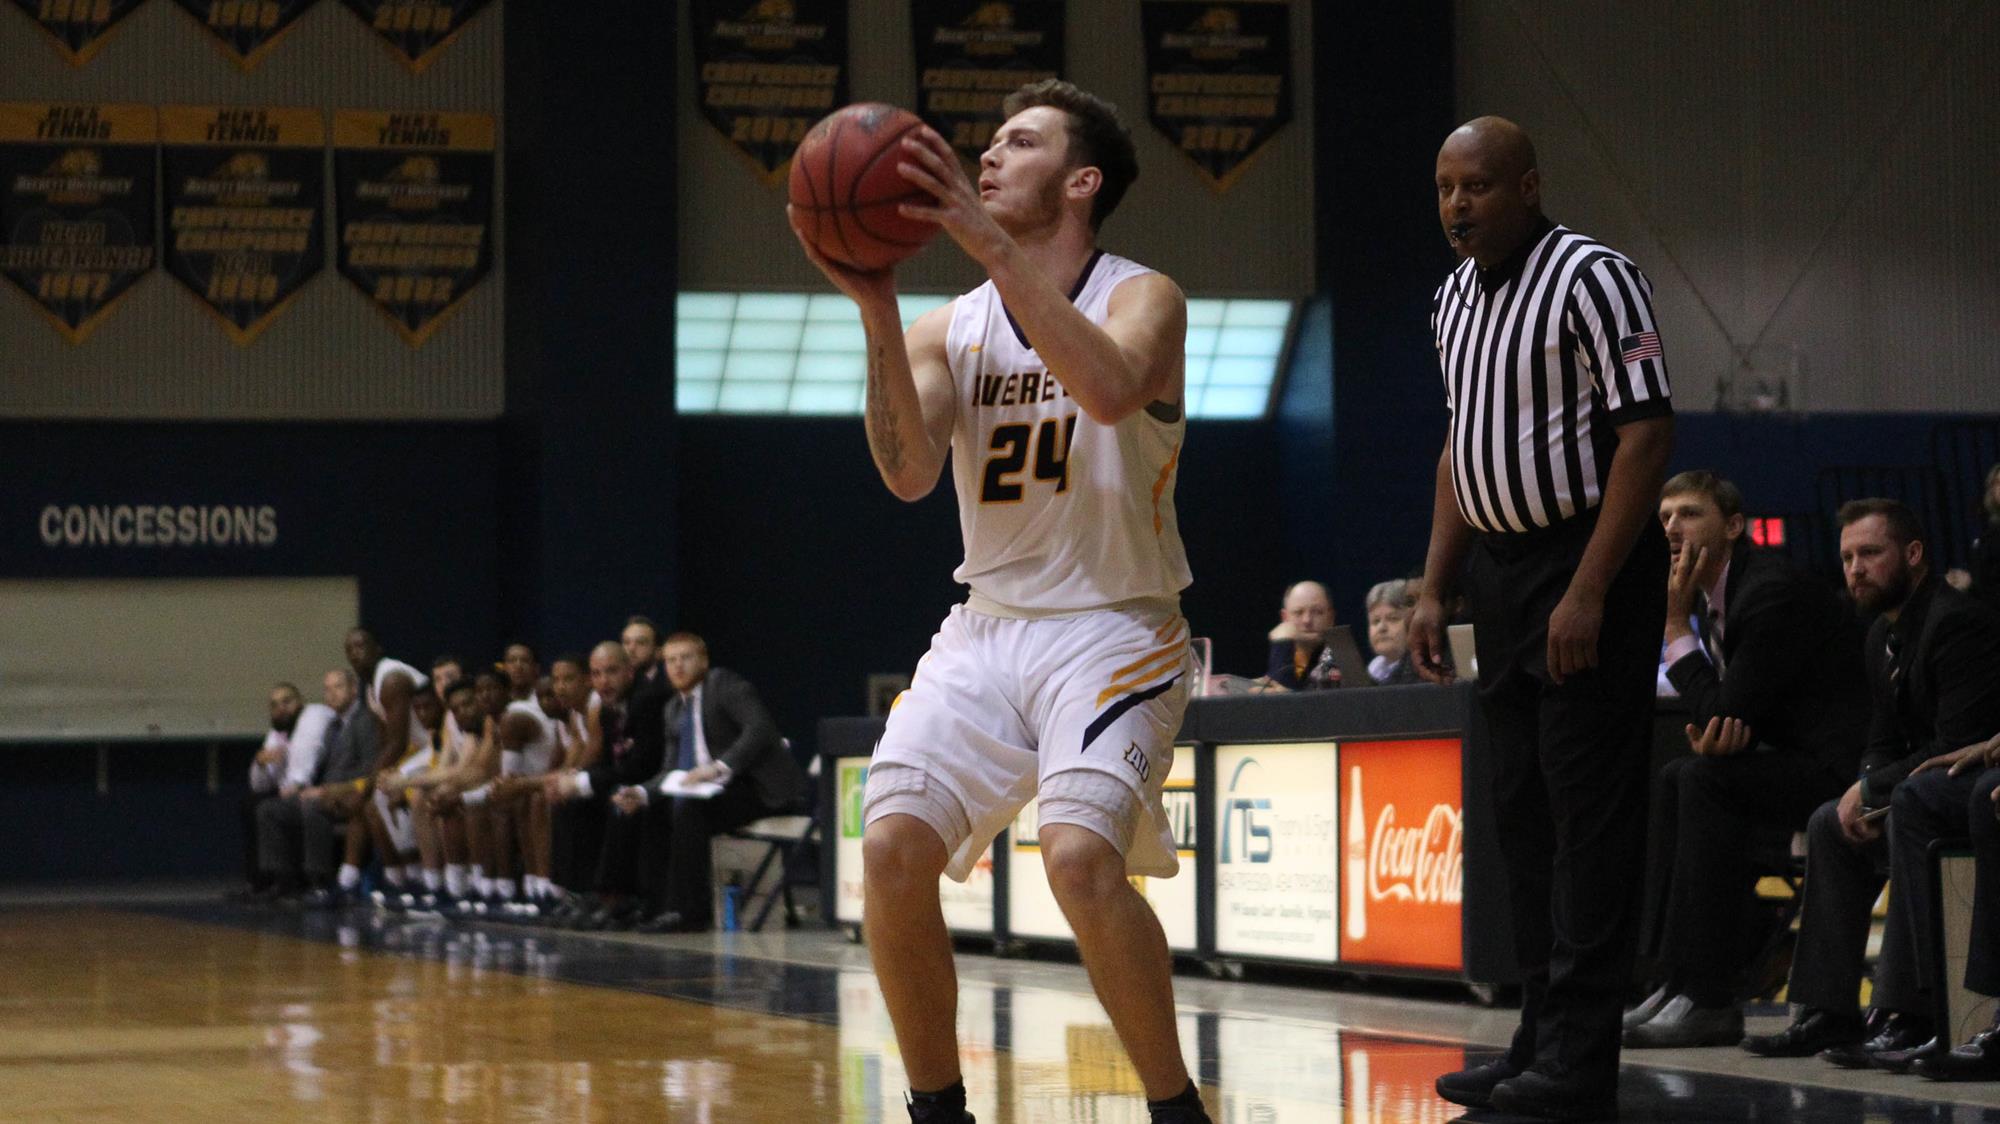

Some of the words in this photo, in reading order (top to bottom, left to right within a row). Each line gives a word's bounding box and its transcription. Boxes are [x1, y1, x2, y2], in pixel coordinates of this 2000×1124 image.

[37, 120, 112, 138] TENNIS
[207, 123, 279, 142] TENNIS
[378, 128, 450, 145] TENNIS
[978, 413, 1077, 505] 24
[39, 504, 278, 547] CONCESSIONS
